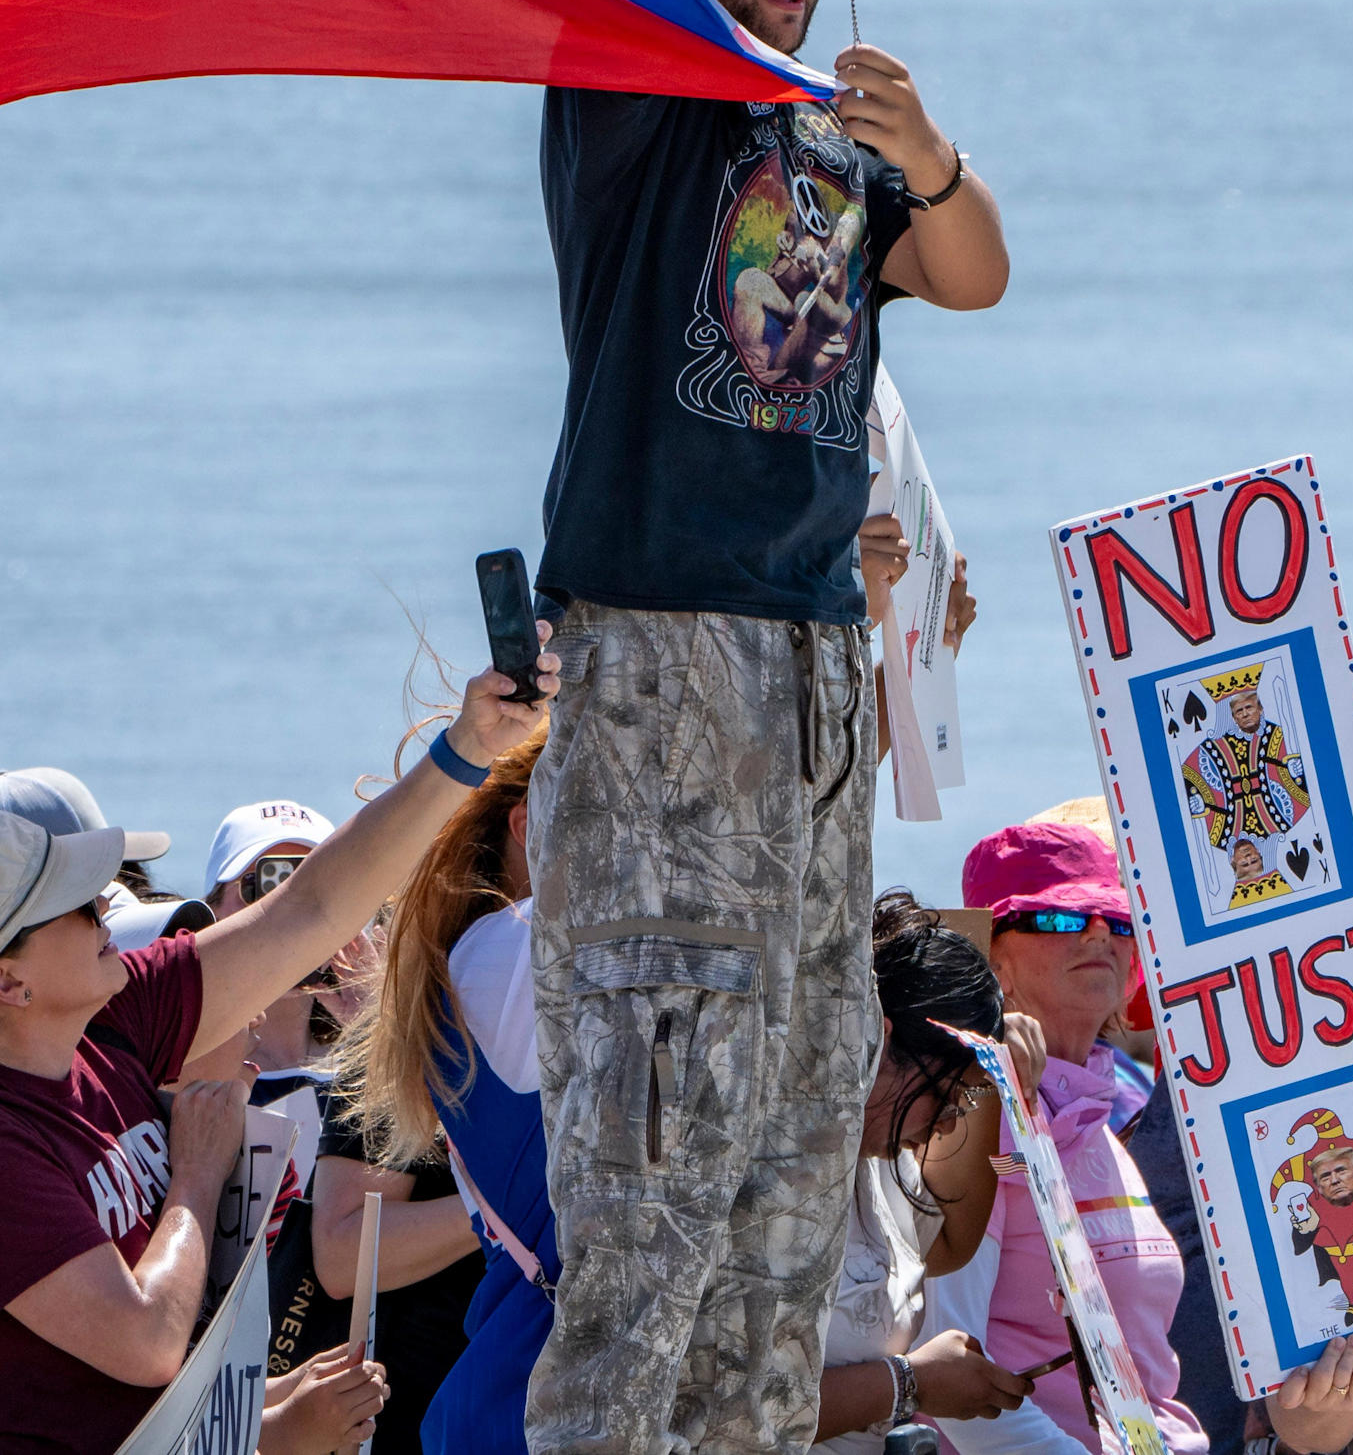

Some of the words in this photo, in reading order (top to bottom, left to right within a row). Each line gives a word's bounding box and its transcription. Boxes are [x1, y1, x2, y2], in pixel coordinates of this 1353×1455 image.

[751, 402, 813, 434] 1972
[1084, 477, 1310, 660] NO
[1161, 687, 1174, 714] K
[260, 804, 313, 824] USA
[1318, 858, 1331, 884] K
[276, 1277, 316, 1354] RNES
[1320, 1324, 1340, 1339] THE
